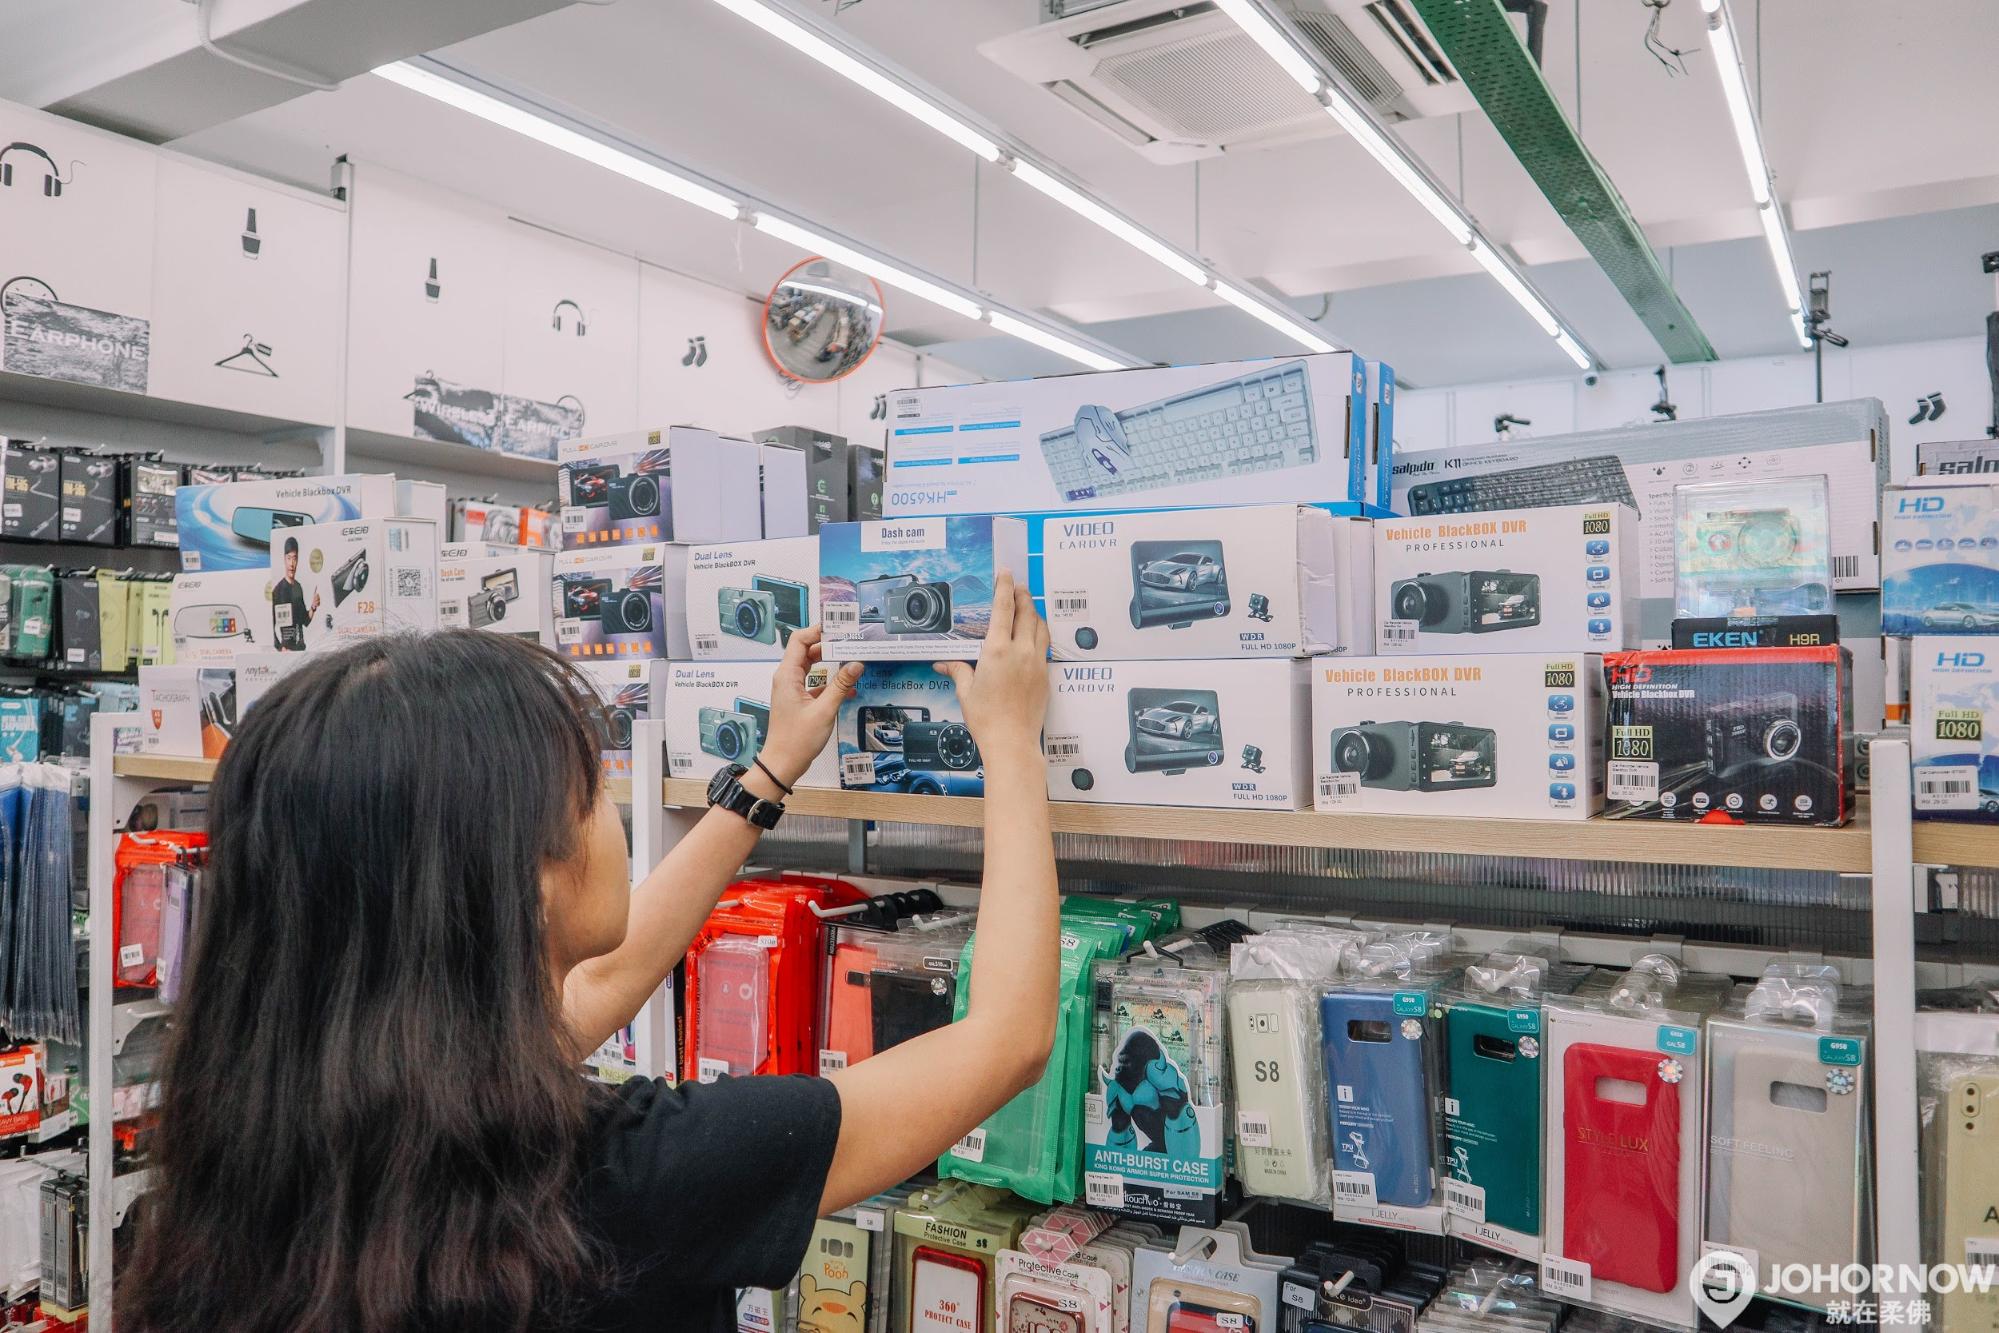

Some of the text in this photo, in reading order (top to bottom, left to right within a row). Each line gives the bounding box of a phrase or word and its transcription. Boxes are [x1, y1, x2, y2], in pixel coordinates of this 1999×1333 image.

[9, 319, 147, 361] EARPHONE
[1444, 458, 1461, 469] K11
[276, 485, 351, 498] Vehicle Blackbox DVR
[891, 491, 947, 506] HK6500
[1899, 496, 1945, 513] HD
[882, 528, 925, 538] Dash cam
[1063, 522, 1114, 536] VIDEO
[1386, 520, 1527, 540] Vehicle BlackBOX DVR
[1584, 520, 1609, 533] 1080
[1059, 538, 1117, 549] CARDVR
[1406, 539, 1504, 551] PROFESSIONAL
[694, 551, 733, 560] Dual Lens
[357, 601, 375, 614] F28
[1693, 632, 1757, 647] EKEN
[1789, 634, 1820, 645] H9R
[1937, 652, 1985, 667] HD
[675, 670, 715, 679] Dual Lens
[1063, 667, 1112, 680] VIDEO
[1326, 667, 1481, 682] Vehicle BlackBOX DVR
[1546, 671, 1574, 686] 1080
[854, 680, 950, 690] ehicle BlackBox DVR
[1059, 684, 1116, 693] CARDVR
[1347, 687, 1456, 696] PROFESSIONAL
[1612, 690, 1640, 699] Vehicle
[1679, 690, 1695, 698] DVR
[1939, 710, 1957, 718] Full
[1615, 729, 1650, 737] Full HD
[1938, 721, 1979, 738] 1080
[1616, 740, 1649, 757] 1080
[1255, 1060, 1280, 1082] S8
[1620, 1139, 1649, 1152] LUX
[1711, 1135, 1793, 1158] SOFT FEELING
[1095, 1149, 1209, 1176] ANTI-BURST CASE
[1447, 1156, 1458, 1165] TPU
[1170, 1174, 1209, 1184] PROTECTION
[1376, 1209, 1398, 1219] JELLY
[925, 1222, 967, 1239] FASHION
[1479, 1228, 1500, 1241] JELLY
[923, 1232, 967, 1247] Protective Case
[976, 1239, 988, 1248] S8
[1082, 1253, 1098, 1262] Case
[824, 1263, 849, 1279] Pooh
[1018, 1258, 1061, 1276] Protective
[1062, 1271, 1079, 1280] Case
[1215, 1272, 1240, 1282] CASE
[1286, 1283, 1297, 1291] For
[1058, 1299, 1078, 1309] S8
[1292, 1294, 1304, 1303] S8
[924, 1310, 972, 1329] PROTECT CASE
[1221, 1317, 1238, 1325] S8
